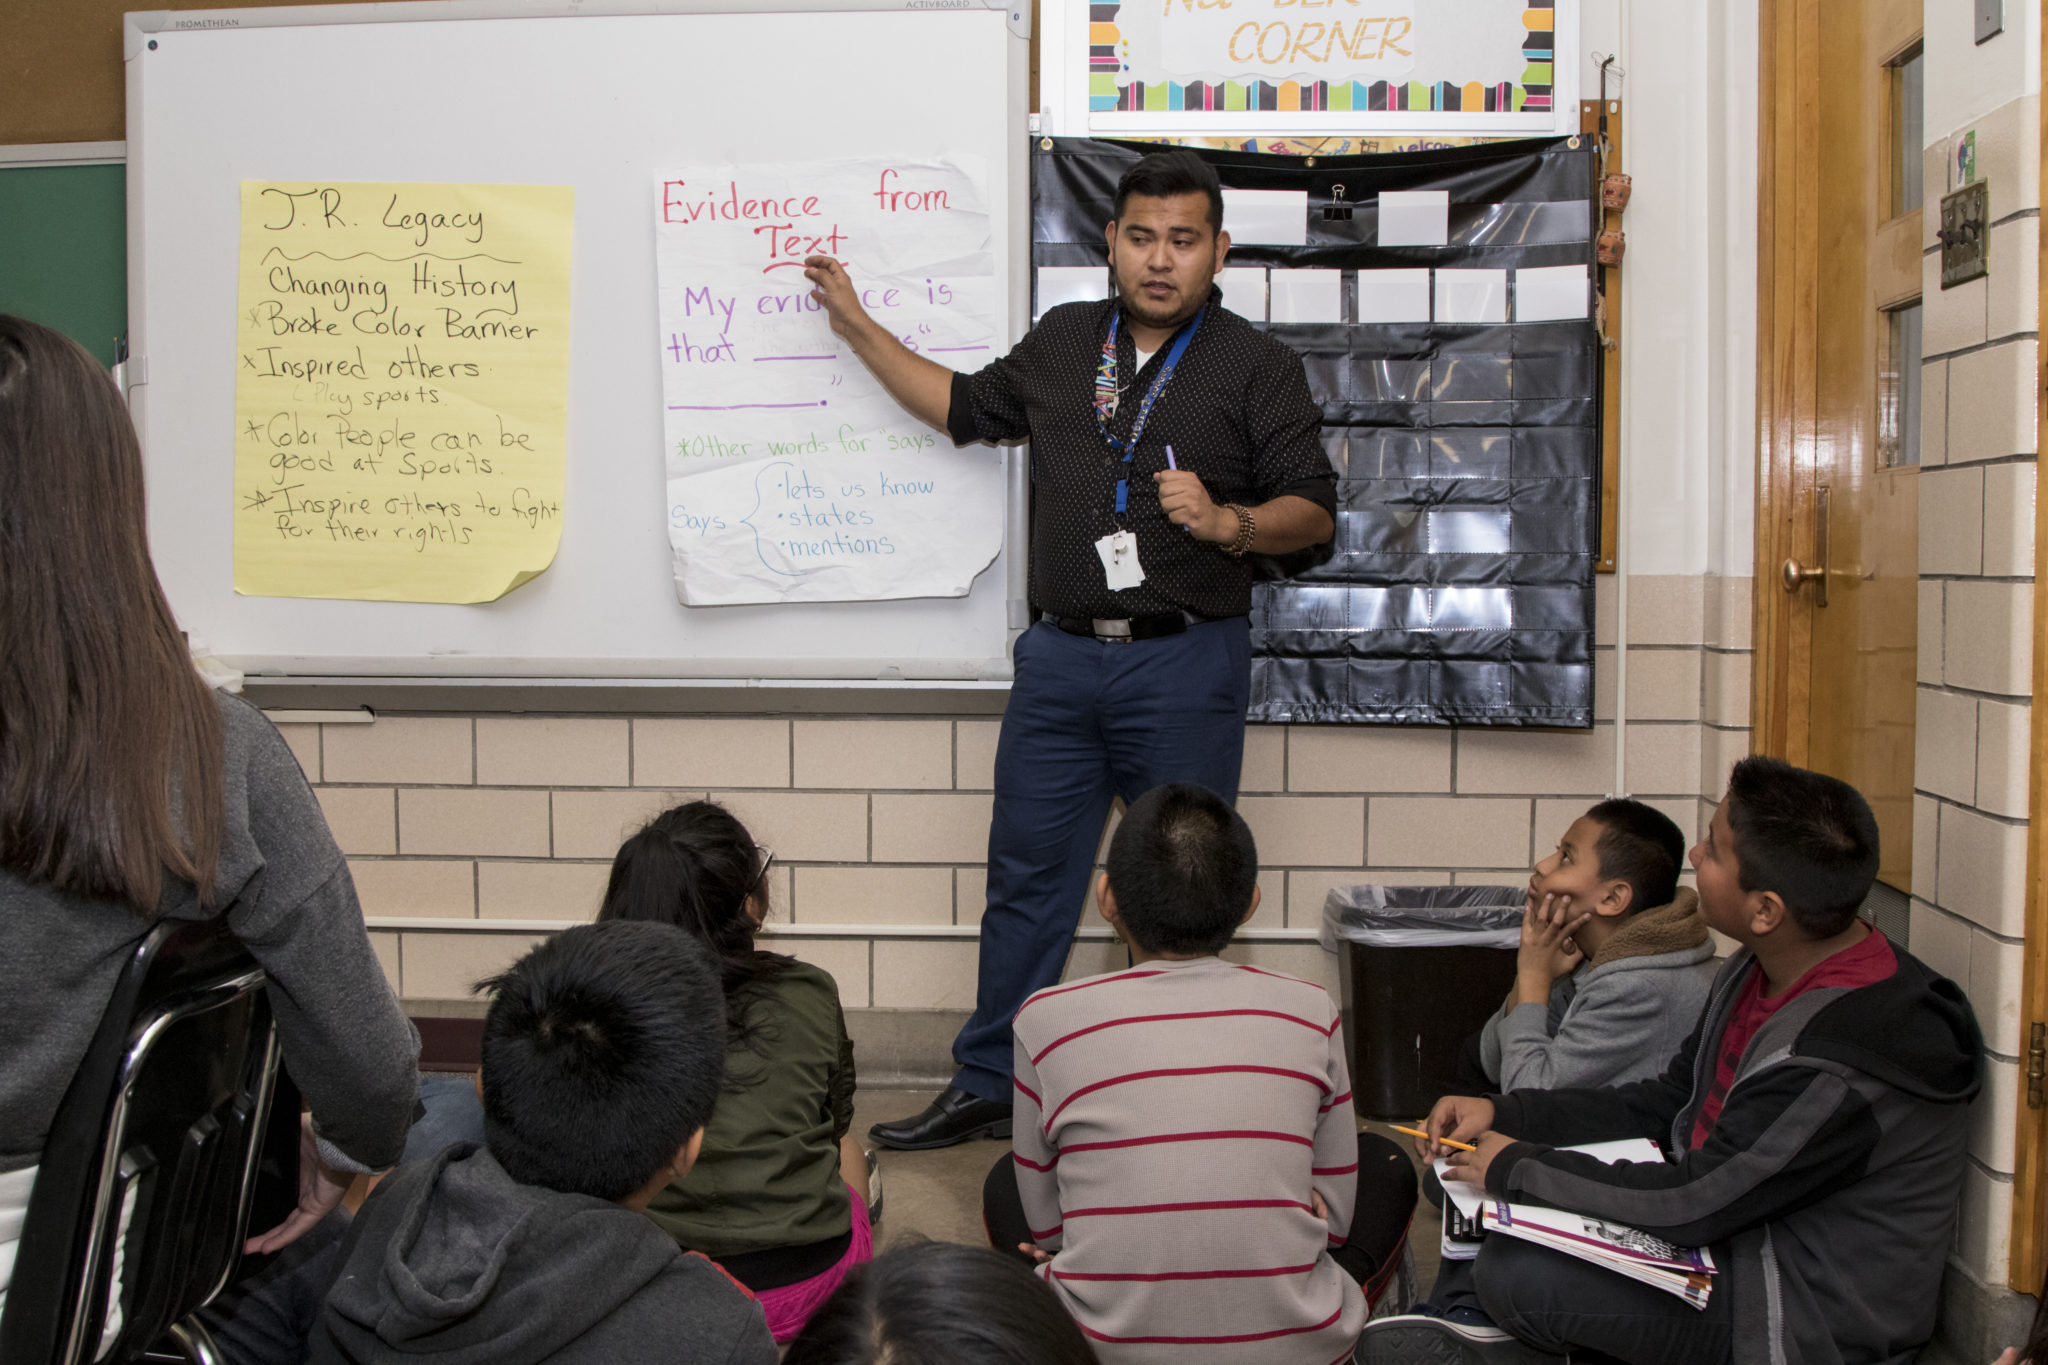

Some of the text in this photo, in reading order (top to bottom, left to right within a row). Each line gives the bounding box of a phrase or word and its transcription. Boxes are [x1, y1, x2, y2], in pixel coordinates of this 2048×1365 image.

[175, 19, 239, 28] PROMETHEAN
[1228, 16, 1413, 64] CORNER
[664, 169, 950, 223] Evidence from
[382, 194, 482, 246] Legacy
[753, 223, 848, 258] Text
[269, 260, 518, 316] Changing History
[685, 286, 736, 334] My
[757, 284, 901, 315] evidce
[925, 278, 952, 305] is
[258, 301, 341, 335] Broke
[353, 306, 426, 338] Color
[257, 346, 369, 382] Inspired
[667, 332, 736, 363] that
[268, 412, 535, 456] Color People can be
[768, 432, 828, 456] words
[838, 423, 871, 454] for
[270, 452, 334, 485] good
[353, 454, 383, 474] at
[784, 470, 934, 499] lets us know
[271, 484, 370, 520] Inspire
[385, 492, 461, 519] others
[476, 491, 501, 518] to
[789, 503, 874, 527] states
[276, 514, 473, 552] for their rights
[671, 505, 726, 536] Says
[788, 532, 895, 556] mentions
